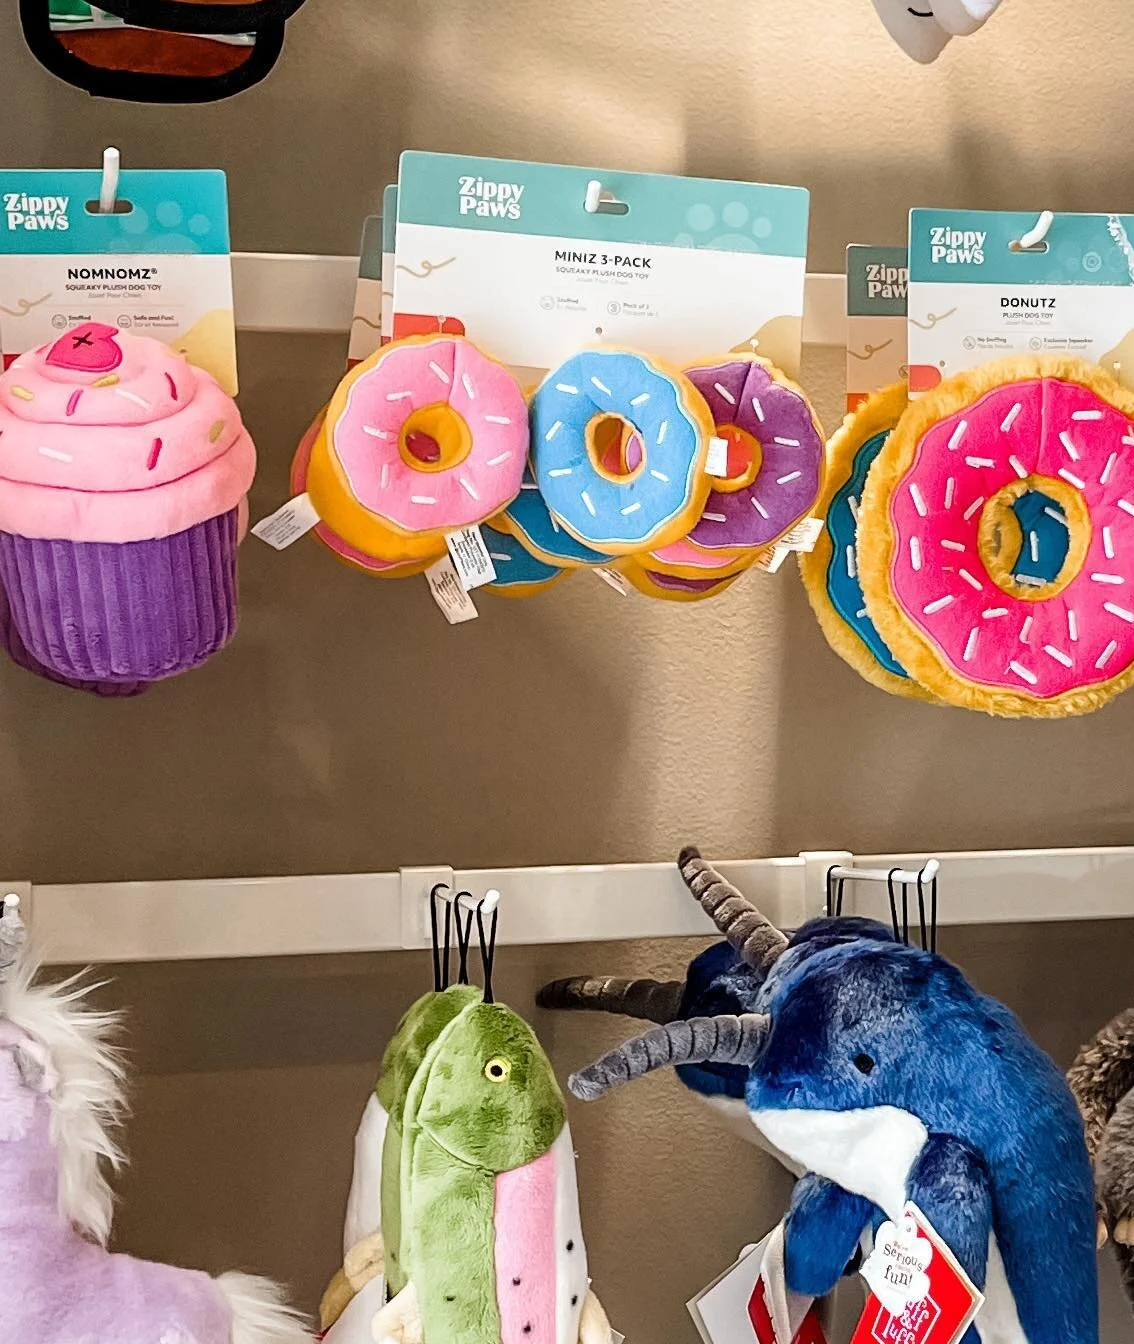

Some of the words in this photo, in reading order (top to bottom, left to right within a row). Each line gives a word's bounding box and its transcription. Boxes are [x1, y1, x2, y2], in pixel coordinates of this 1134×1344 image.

[458, 175, 525, 203] Zippy
[3, 192, 69, 217] Zippy
[459, 198, 521, 220] Paws
[7, 210, 69, 231] Paws
[930, 227, 987, 250] Zippy
[554, 250, 598, 265] MINIZ
[599, 252, 652, 270] 3-PACK
[931, 245, 985, 265] Paws
[555, 267, 590, 275] SQUEAKY
[65, 284, 101, 292] SQUEAKY
[103, 284, 127, 292] PLUSH
[128, 284, 146, 292] DOG
[147, 284, 162, 292] TOY
[1000, 296, 1056, 309] DONUTZ
[1002, 311, 1023, 319] PLUSH
[1024, 311, 1039, 319] DOG
[1040, 312, 1054, 320] TOY
[882, 1242, 924, 1273] Serious
[883, 1264, 914, 1287] fun!
